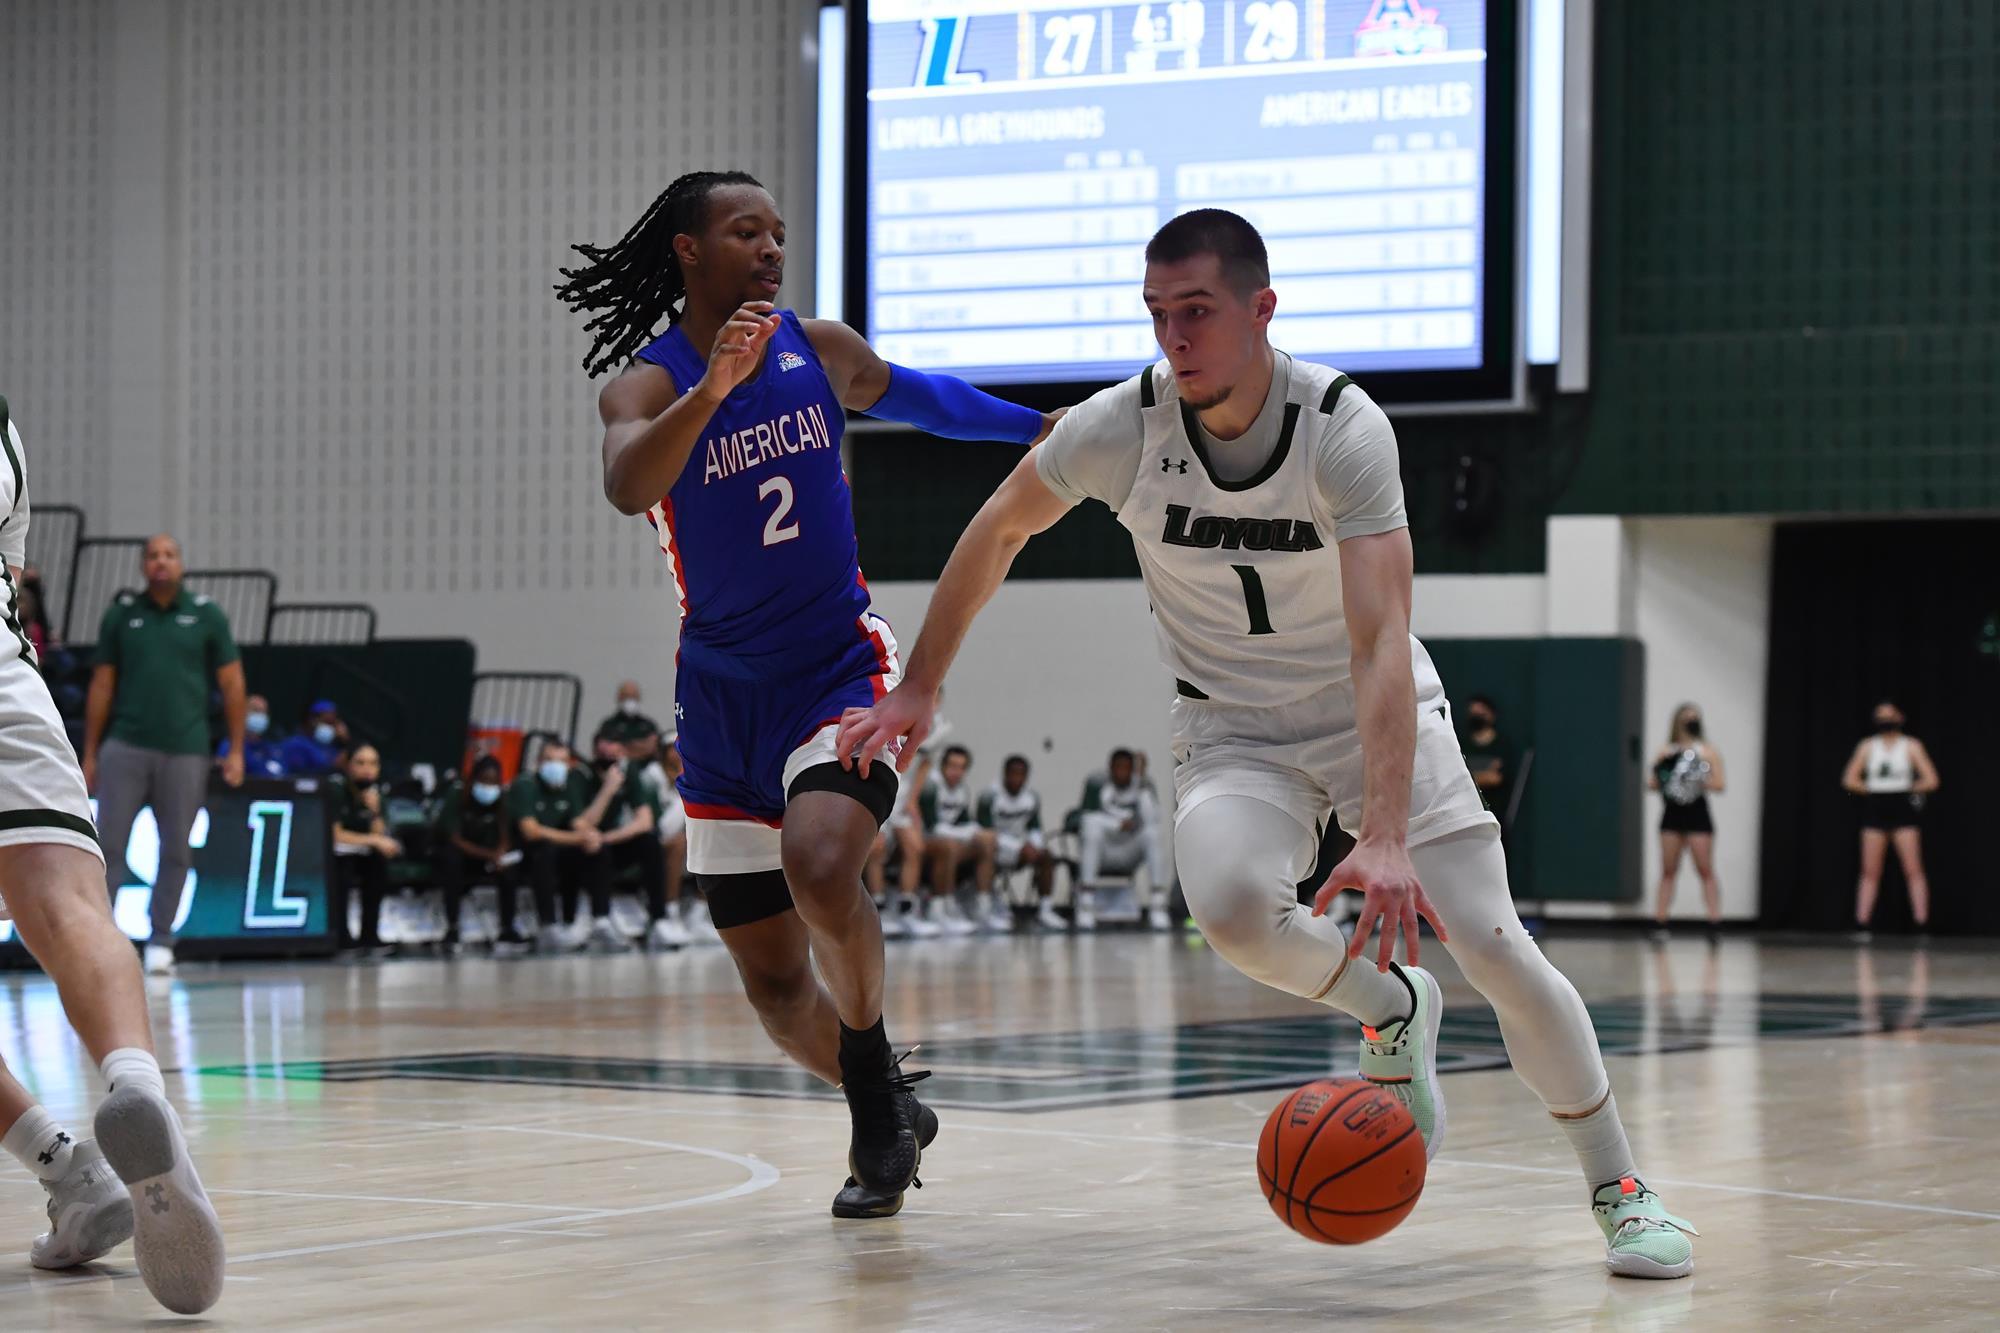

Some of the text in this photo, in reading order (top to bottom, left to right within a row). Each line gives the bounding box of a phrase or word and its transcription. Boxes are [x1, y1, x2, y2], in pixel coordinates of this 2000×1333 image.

[1043, 14, 1097, 75] 27
[1244, 0, 1299, 63] 29
[878, 105, 1105, 150] LOYOLA GREYHOUNDS
[1260, 80, 1473, 128] AMERICAN EAGLES
[704, 403, 831, 486] AMERICAN
[758, 475, 800, 547] 2
[1230, 564, 1278, 635] 1
[244, 801, 308, 929] L
